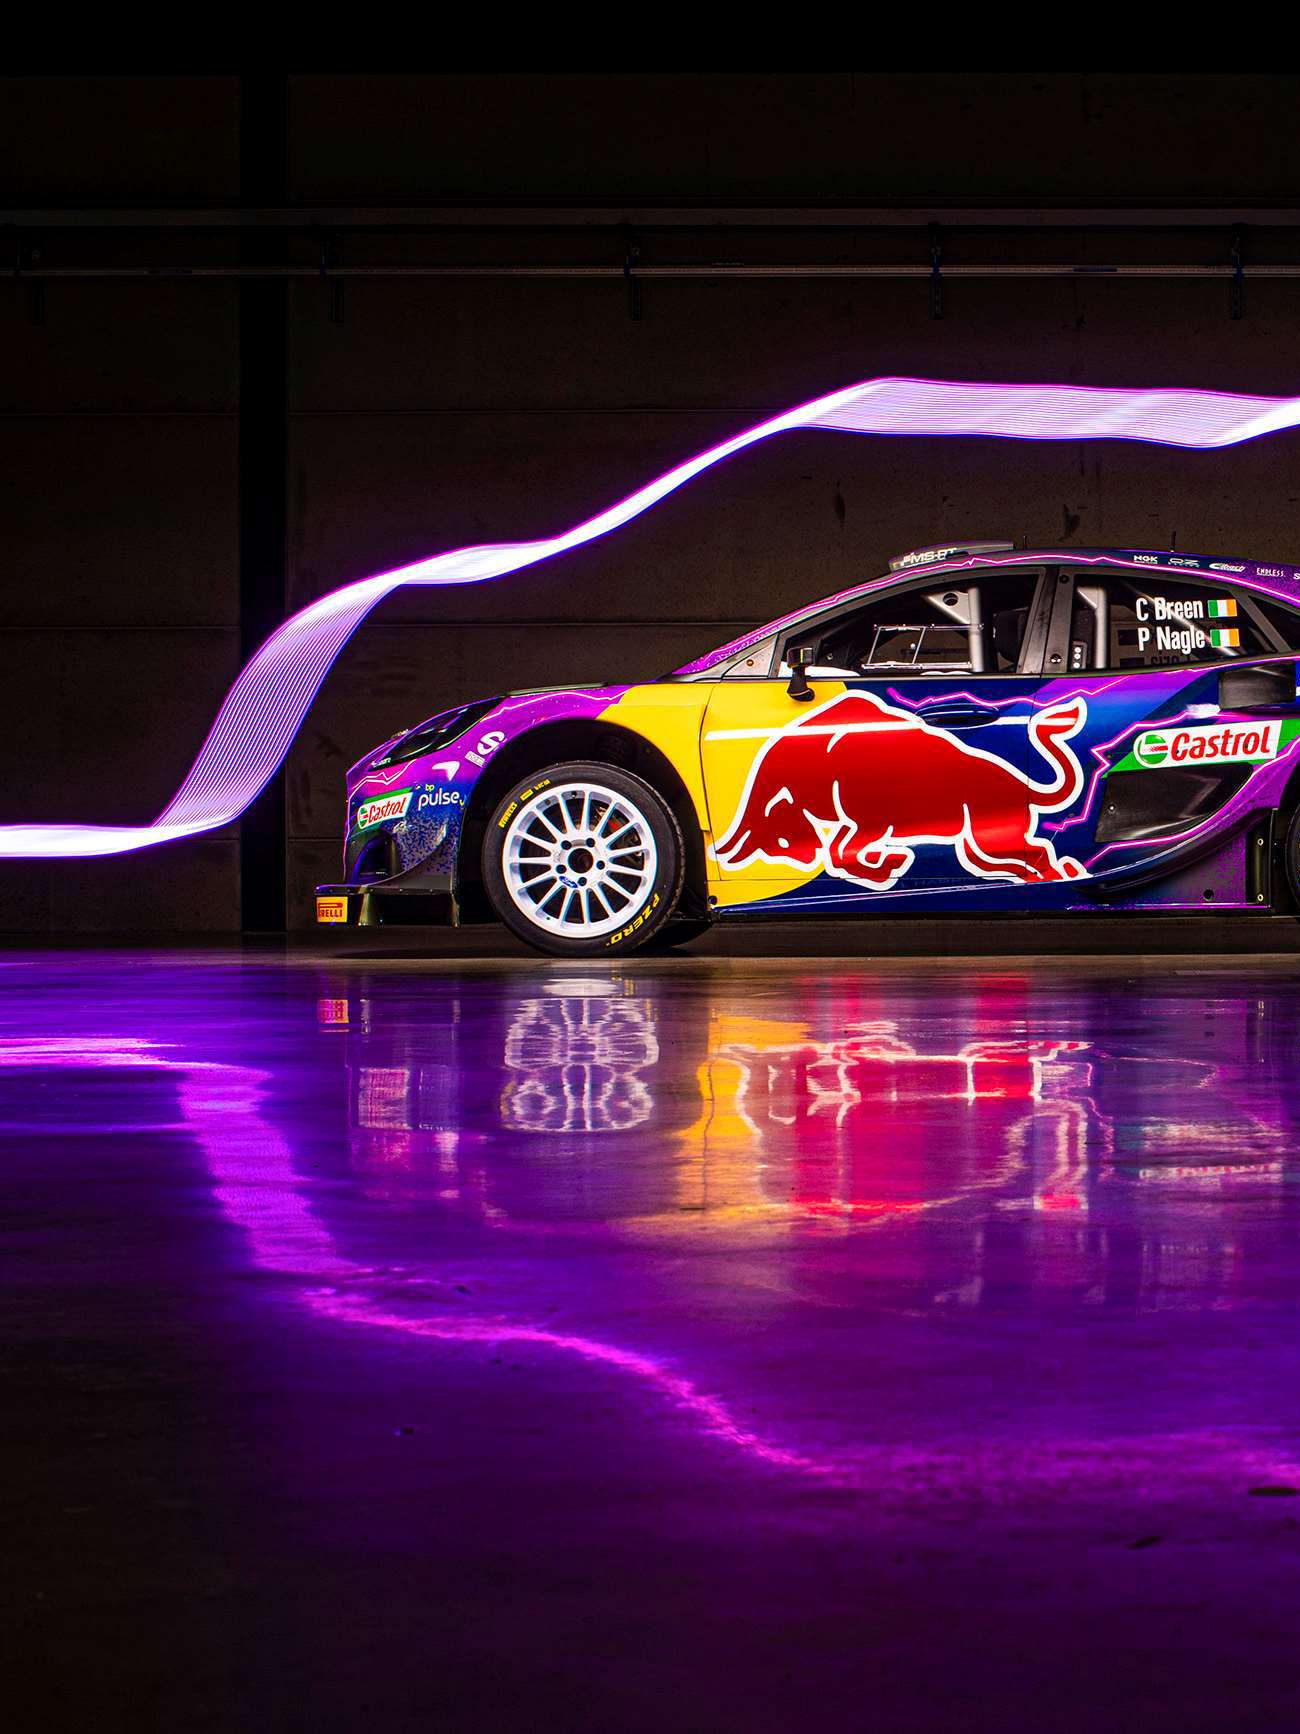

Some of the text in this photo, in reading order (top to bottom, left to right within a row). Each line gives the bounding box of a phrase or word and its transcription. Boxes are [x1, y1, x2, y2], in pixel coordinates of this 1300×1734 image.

[1136, 597, 1204, 621] C Breen
[1137, 624, 1206, 655] P Nagle
[1170, 725, 1271, 761] Castrol
[418, 788, 460, 811] pulse
[425, 784, 435, 792] bp
[368, 797, 407, 823] Castrol
